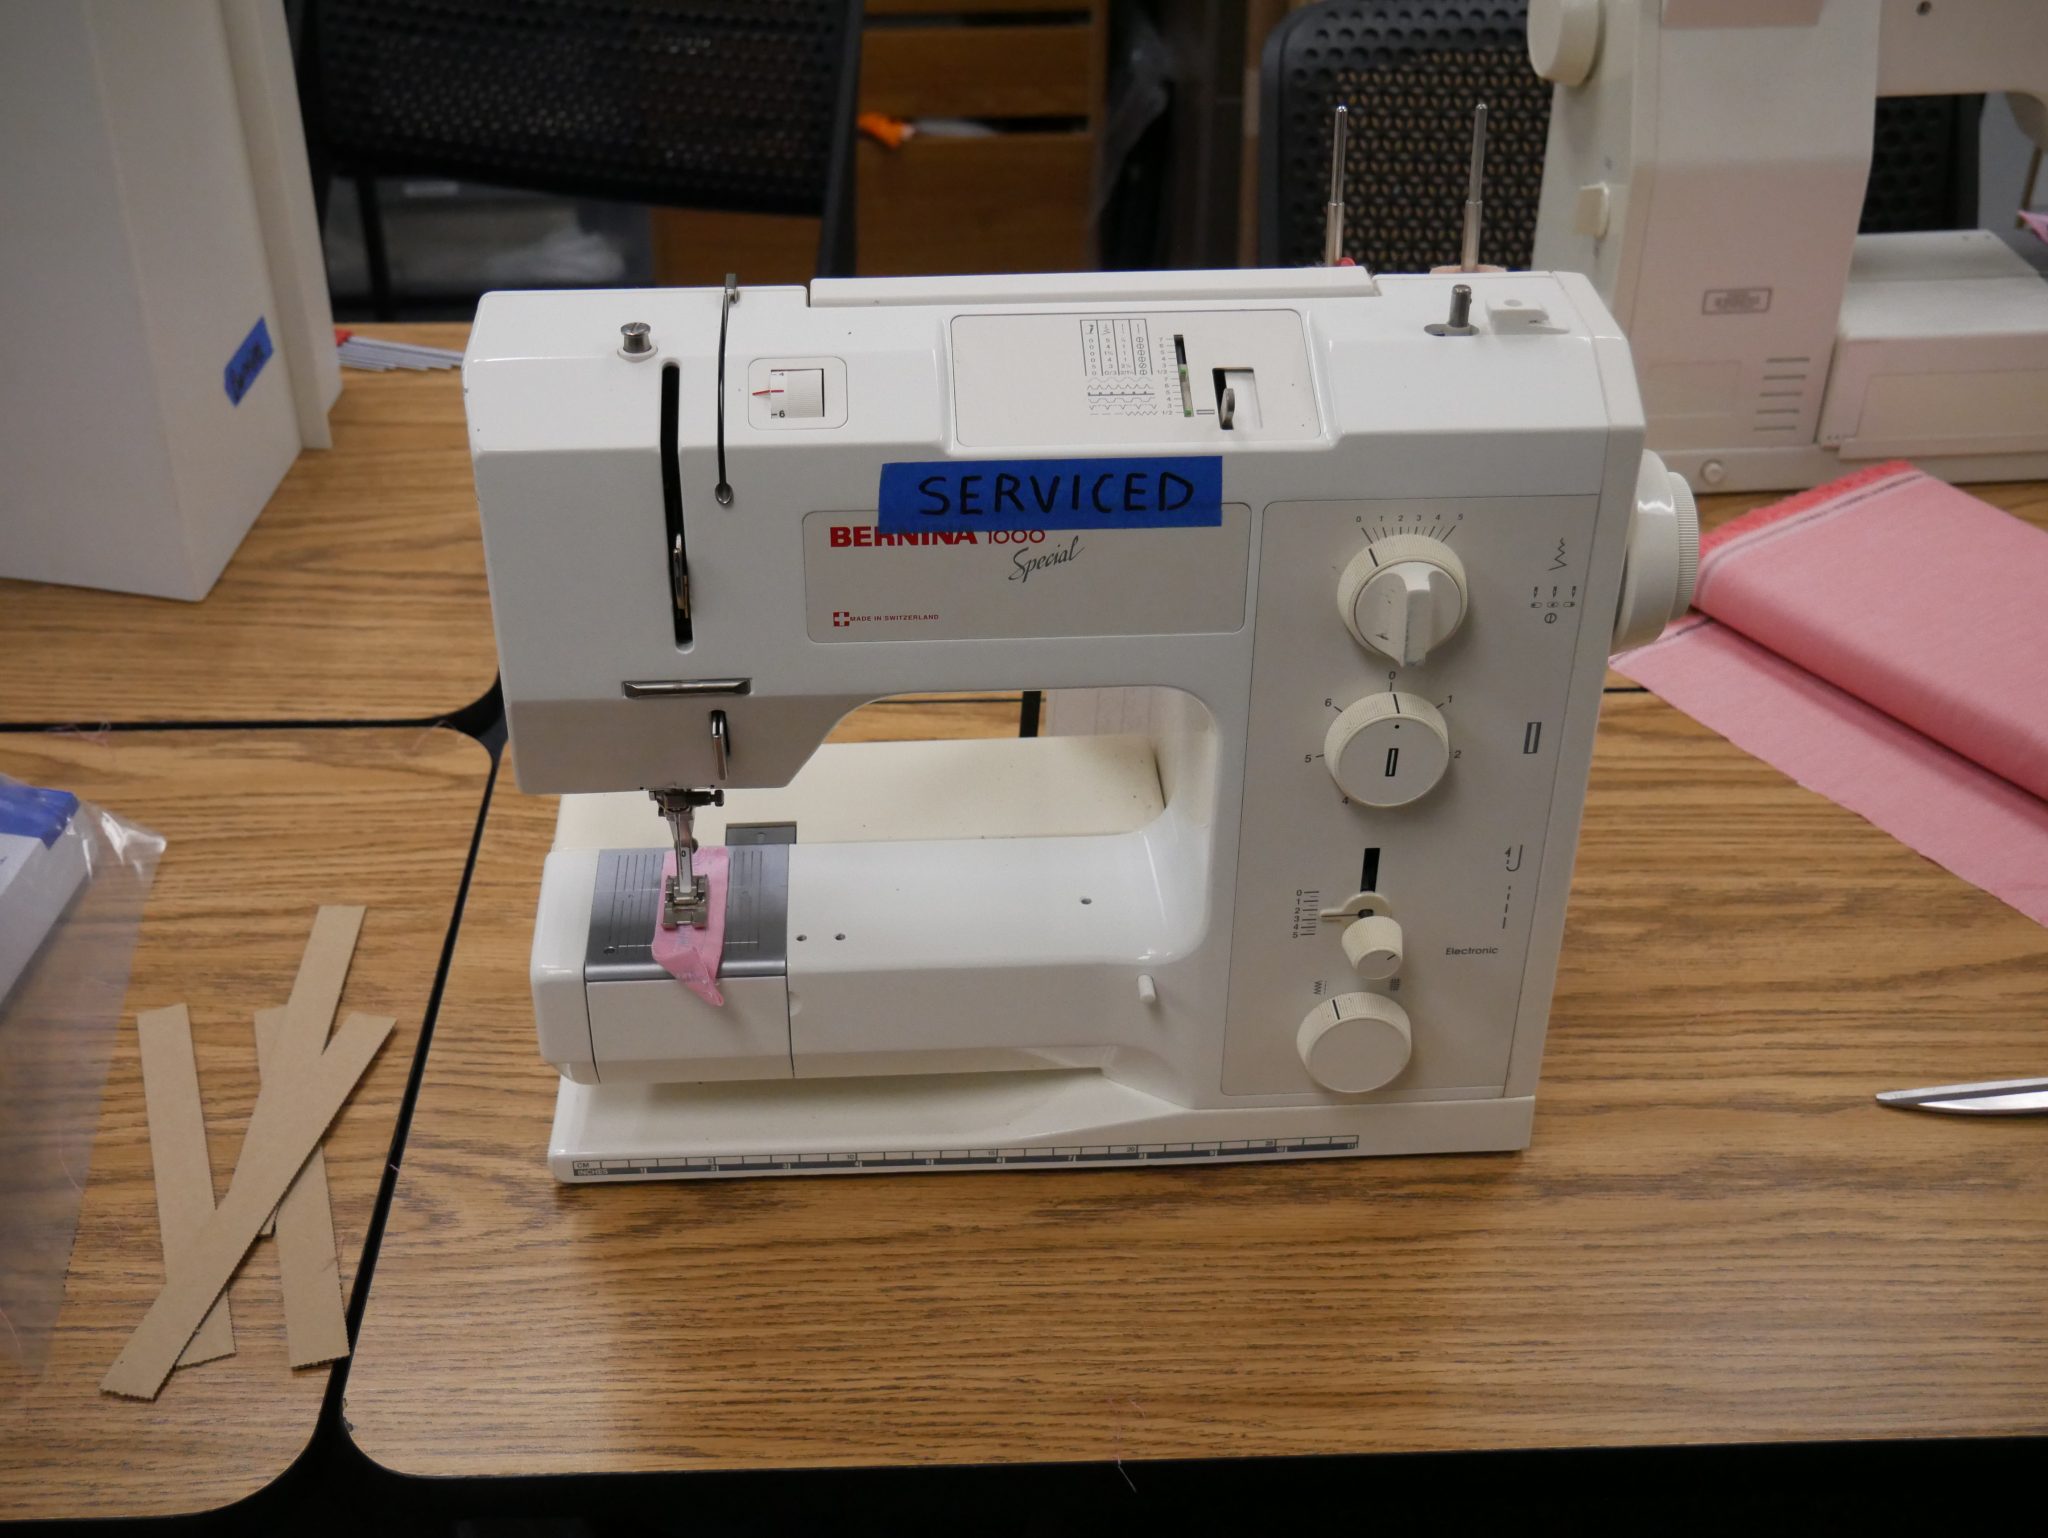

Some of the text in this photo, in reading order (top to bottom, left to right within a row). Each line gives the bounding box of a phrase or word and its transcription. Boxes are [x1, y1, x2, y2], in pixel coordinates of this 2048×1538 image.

[778, 410, 786, 418] 6
[918, 471, 1195, 516] SERVICED
[988, 529, 1046, 545] 1000
[1008, 535, 1086, 583] Special
[1388, 671, 1396, 680] 0
[1324, 698, 1332, 707] 6
[1304, 754, 1312, 764] 5
[1454, 750, 1462, 758] 2
[1445, 946, 1499, 956] Electronic
